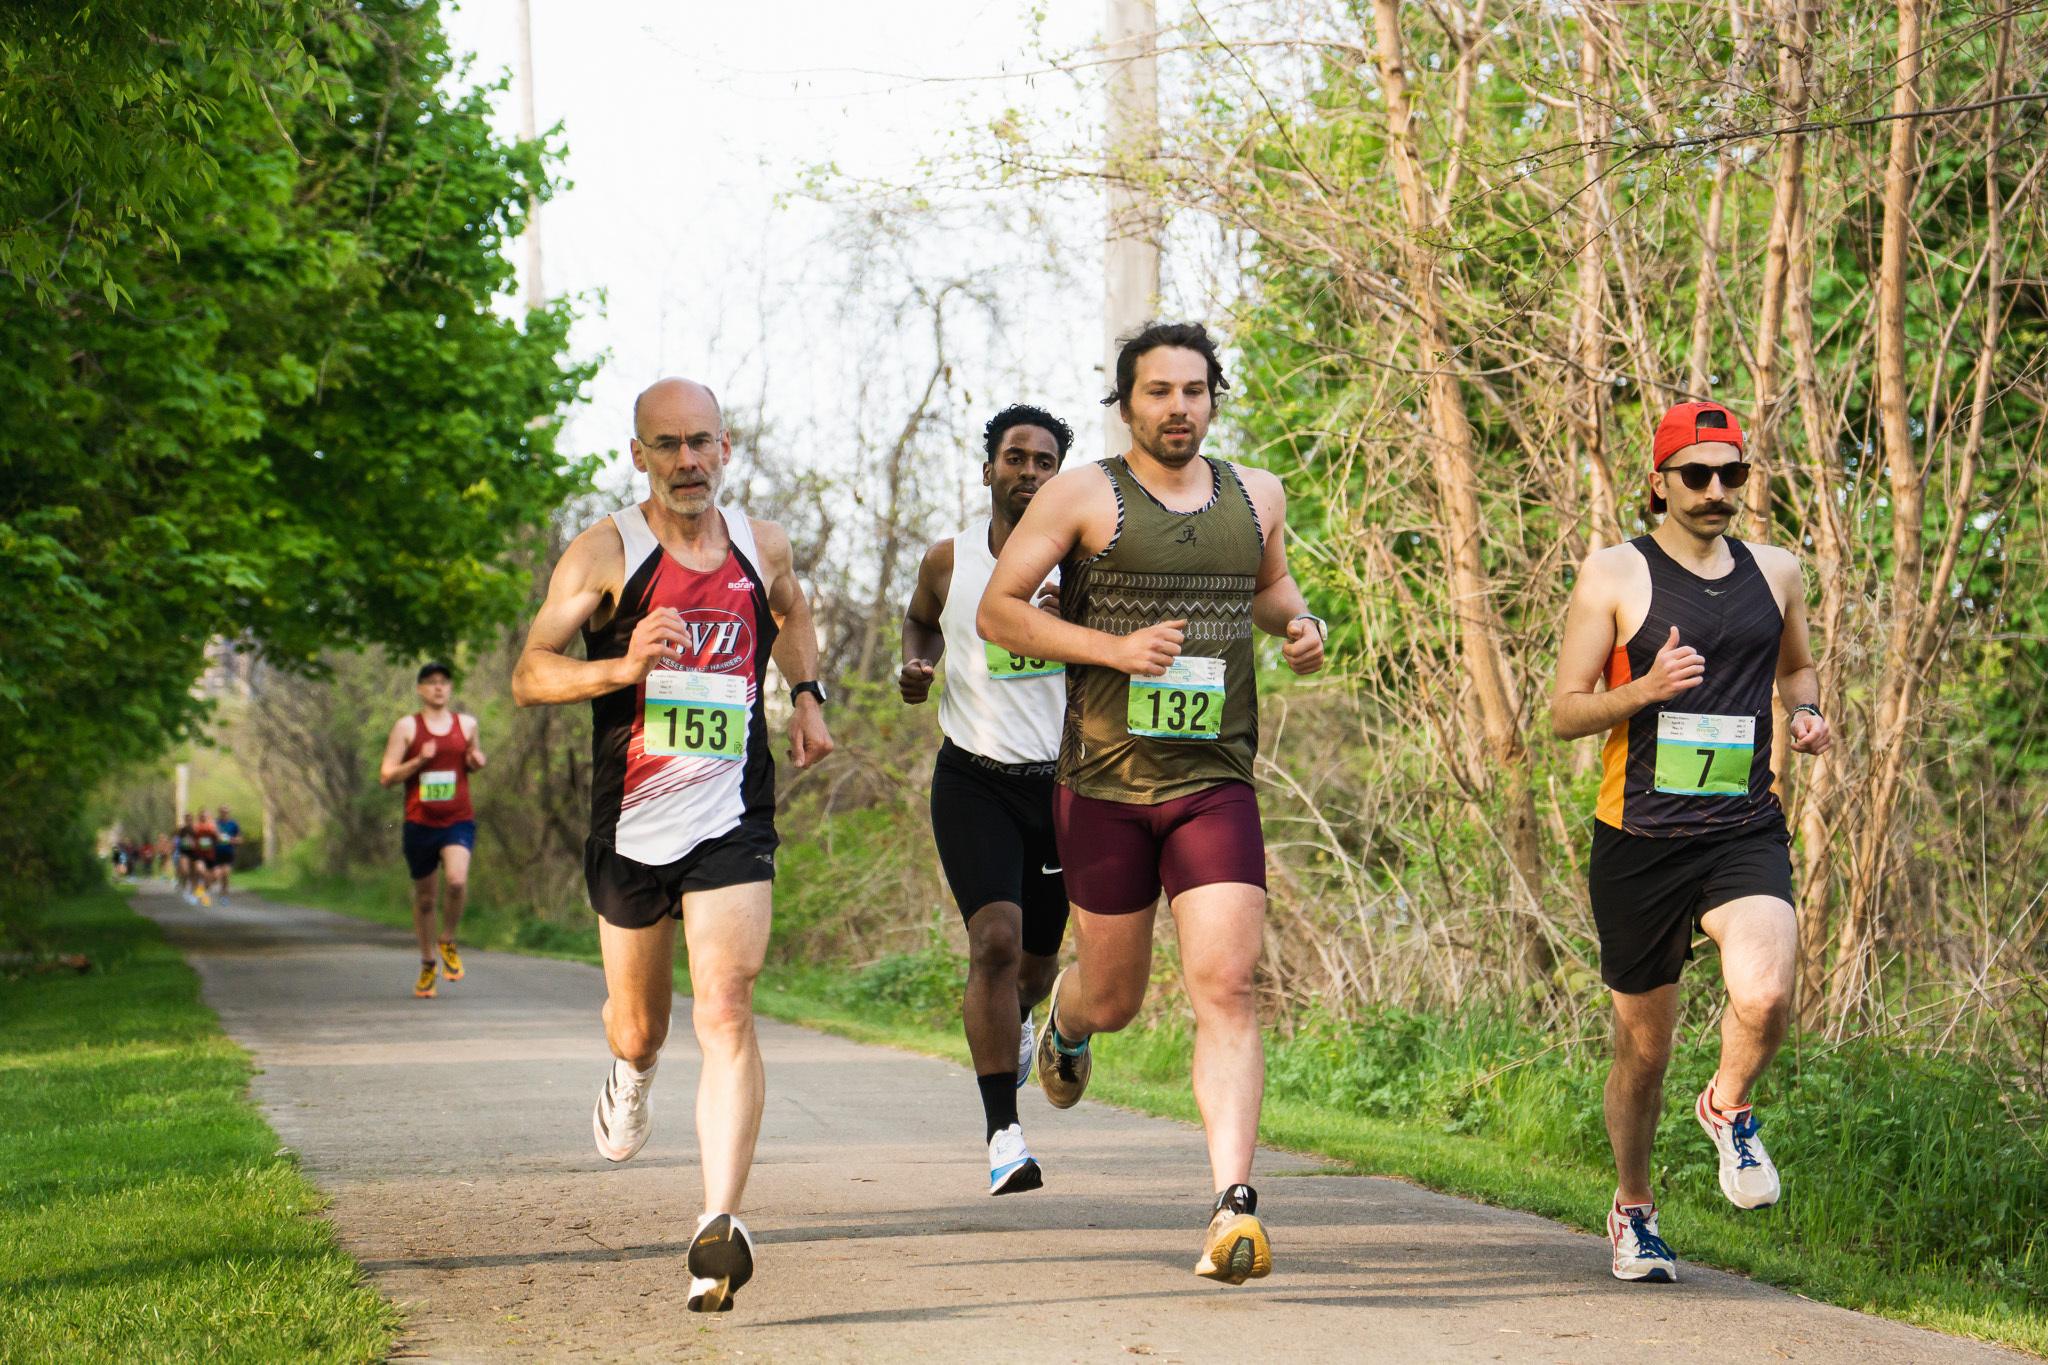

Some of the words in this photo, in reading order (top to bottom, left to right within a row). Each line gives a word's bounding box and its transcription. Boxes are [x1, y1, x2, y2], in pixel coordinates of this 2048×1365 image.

[663, 707, 727, 751] 153
[1147, 690, 1209, 731] 132
[969, 755, 1022, 776] NIKE
[1025, 764, 1057, 776] PR
[1696, 748, 1715, 787] 7
